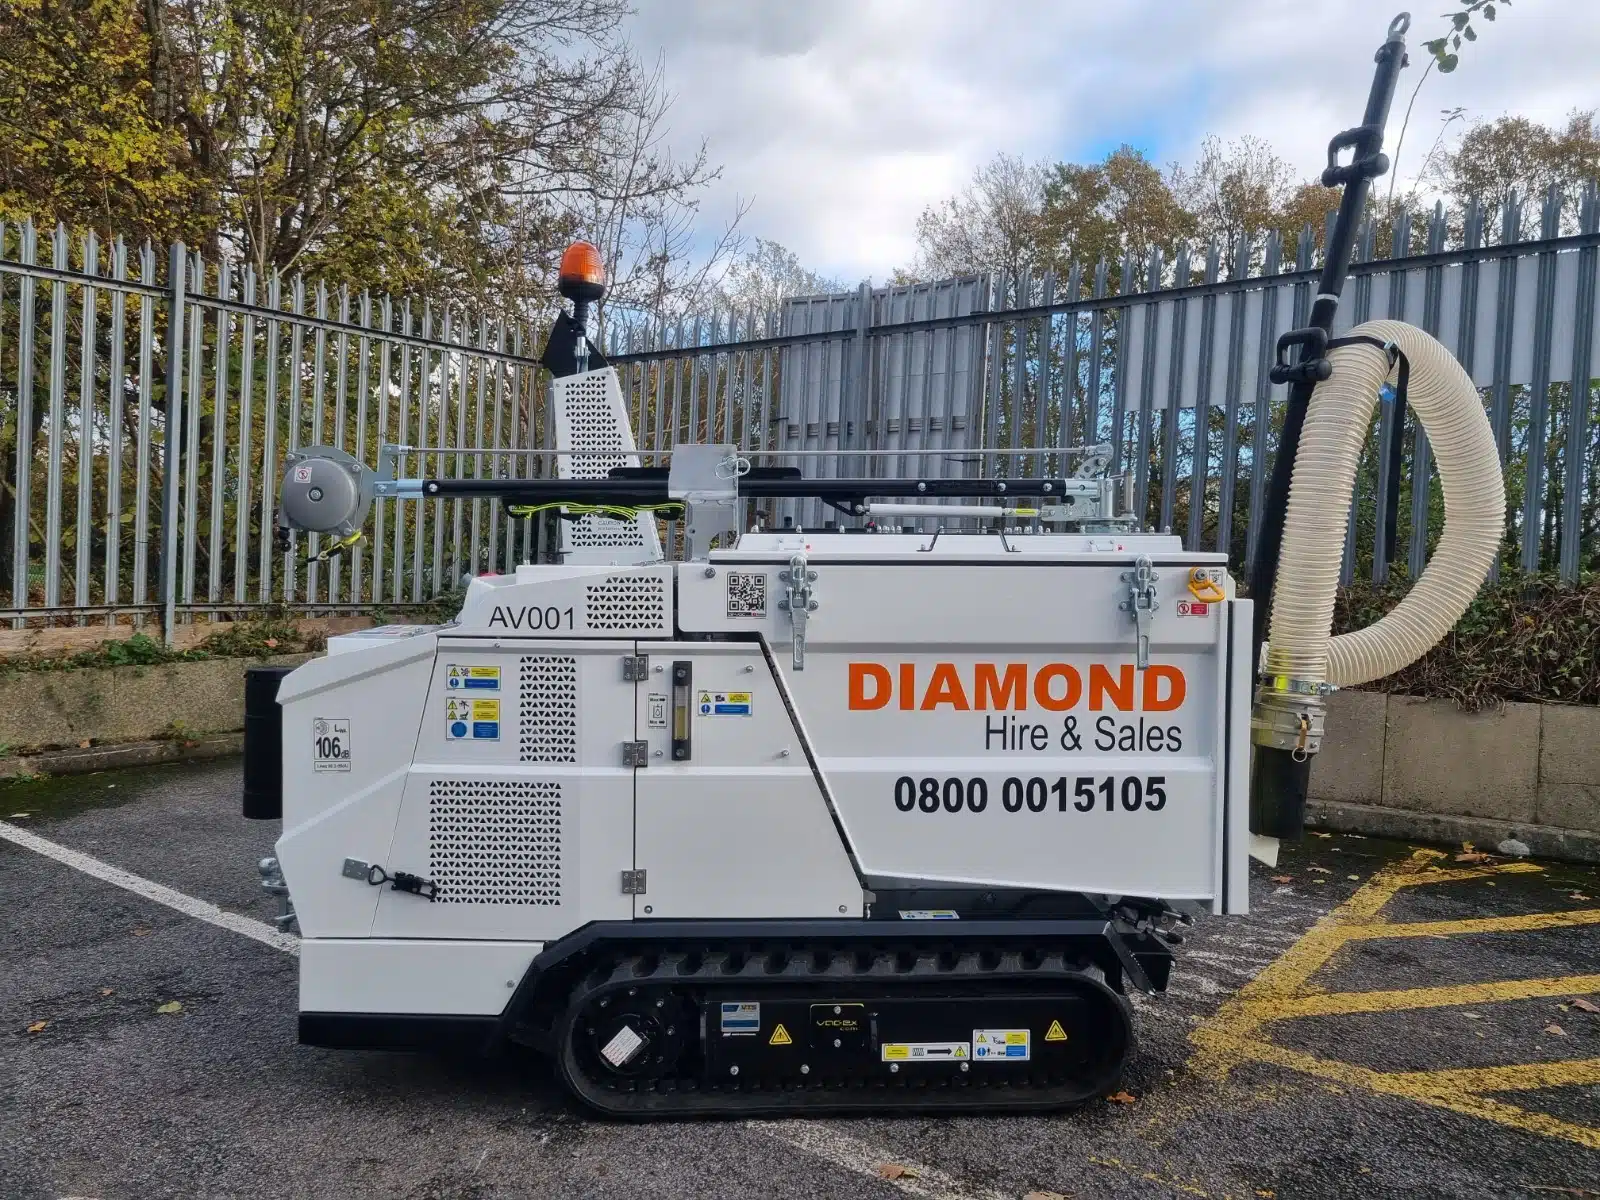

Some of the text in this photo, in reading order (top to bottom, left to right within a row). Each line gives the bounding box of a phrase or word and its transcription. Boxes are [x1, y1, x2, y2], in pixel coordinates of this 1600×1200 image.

[488, 606, 574, 630] AV001
[848, 663, 1187, 712] DIAMOND
[315, 736, 341, 759] 106
[985, 715, 1183, 753] Hire & Sales
[894, 776, 1167, 814] 0800 0015105
